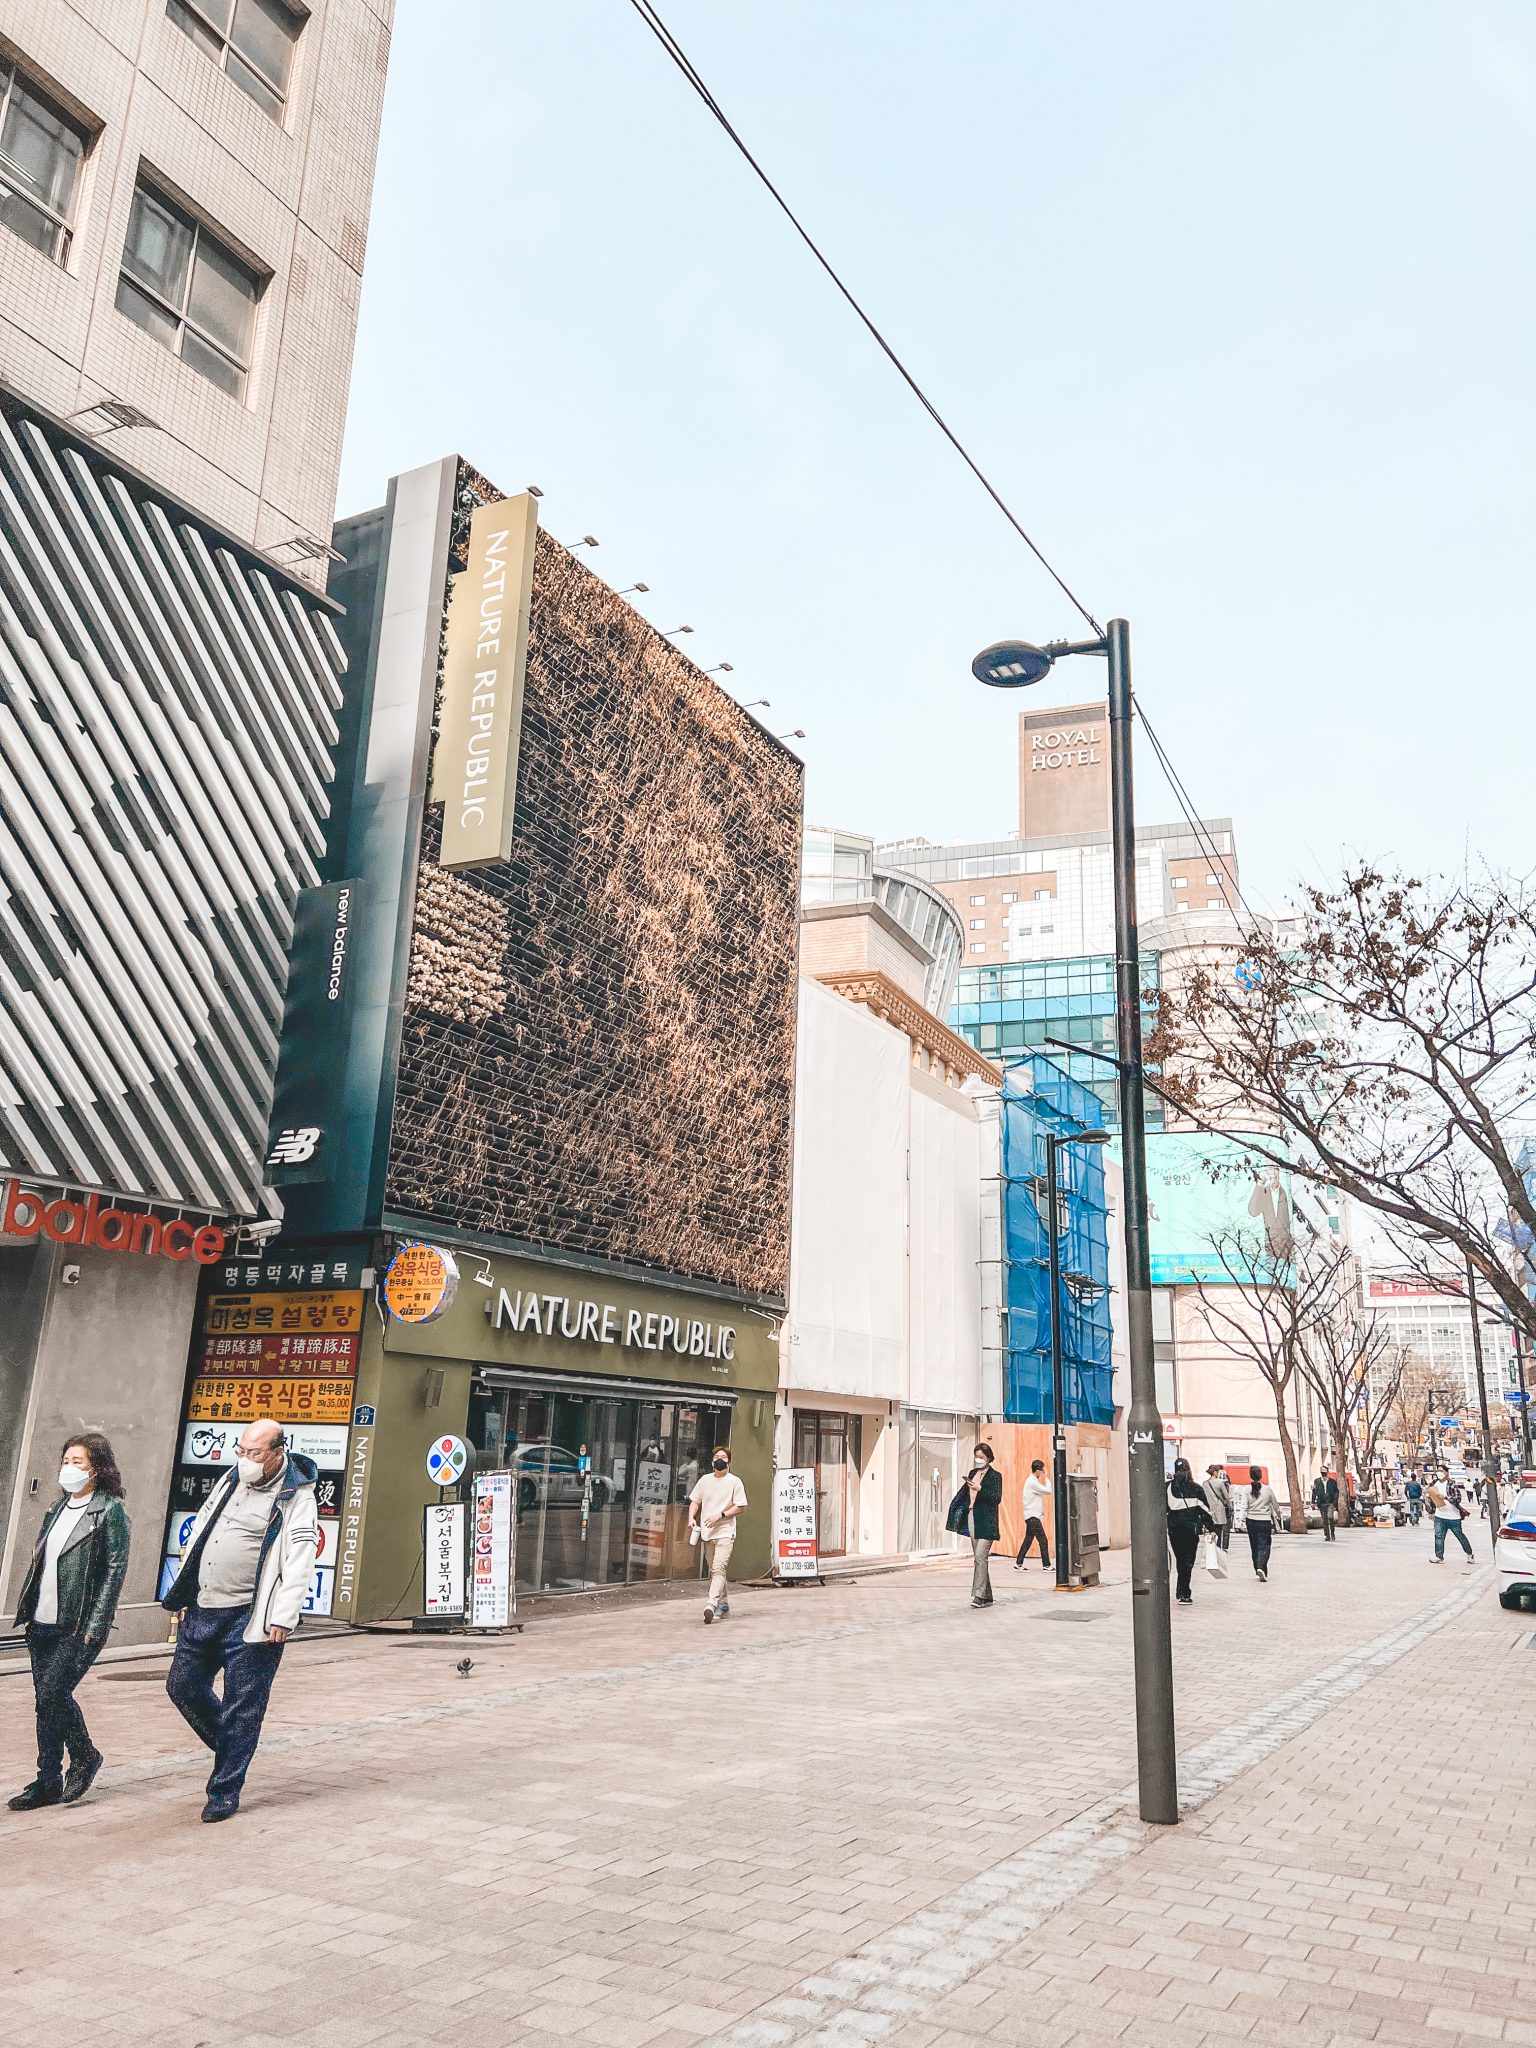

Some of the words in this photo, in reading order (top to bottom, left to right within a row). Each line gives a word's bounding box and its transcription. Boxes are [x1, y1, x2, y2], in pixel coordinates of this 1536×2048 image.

[477, 529, 510, 659] NATURE
[460, 668, 496, 829] REPUBLIC
[1031, 728, 1101, 751] ROYAL
[1031, 748, 1101, 772] HOTEL
[337, 888, 350, 924] new
[327, 926, 348, 1000] balance
[3, 1178, 225, 1264] balance
[225, 1262, 348, 1287] 명동먹자골목
[392, 1260, 443, 1277] 정육식당
[280, 1305, 357, 1329] 설렁탕
[496, 1287, 616, 1344] NATURE
[625, 1309, 737, 1361] REPUBLIC
[195, 1382, 236, 1398] 착한한우
[236, 1382, 316, 1409] 정육식당
[317, 1383, 351, 1396] 한우등심
[191, 1402, 233, 1417] 中一會館
[326, 1398, 350, 1409] 35,000
[359, 1415, 369, 1424] 27
[349, 1436, 369, 1508] NATURE
[779, 1488, 814, 1500] 서울복집
[339, 1515, 361, 1603] REPUBLIC
[438, 1525, 453, 1602] 서울복집
